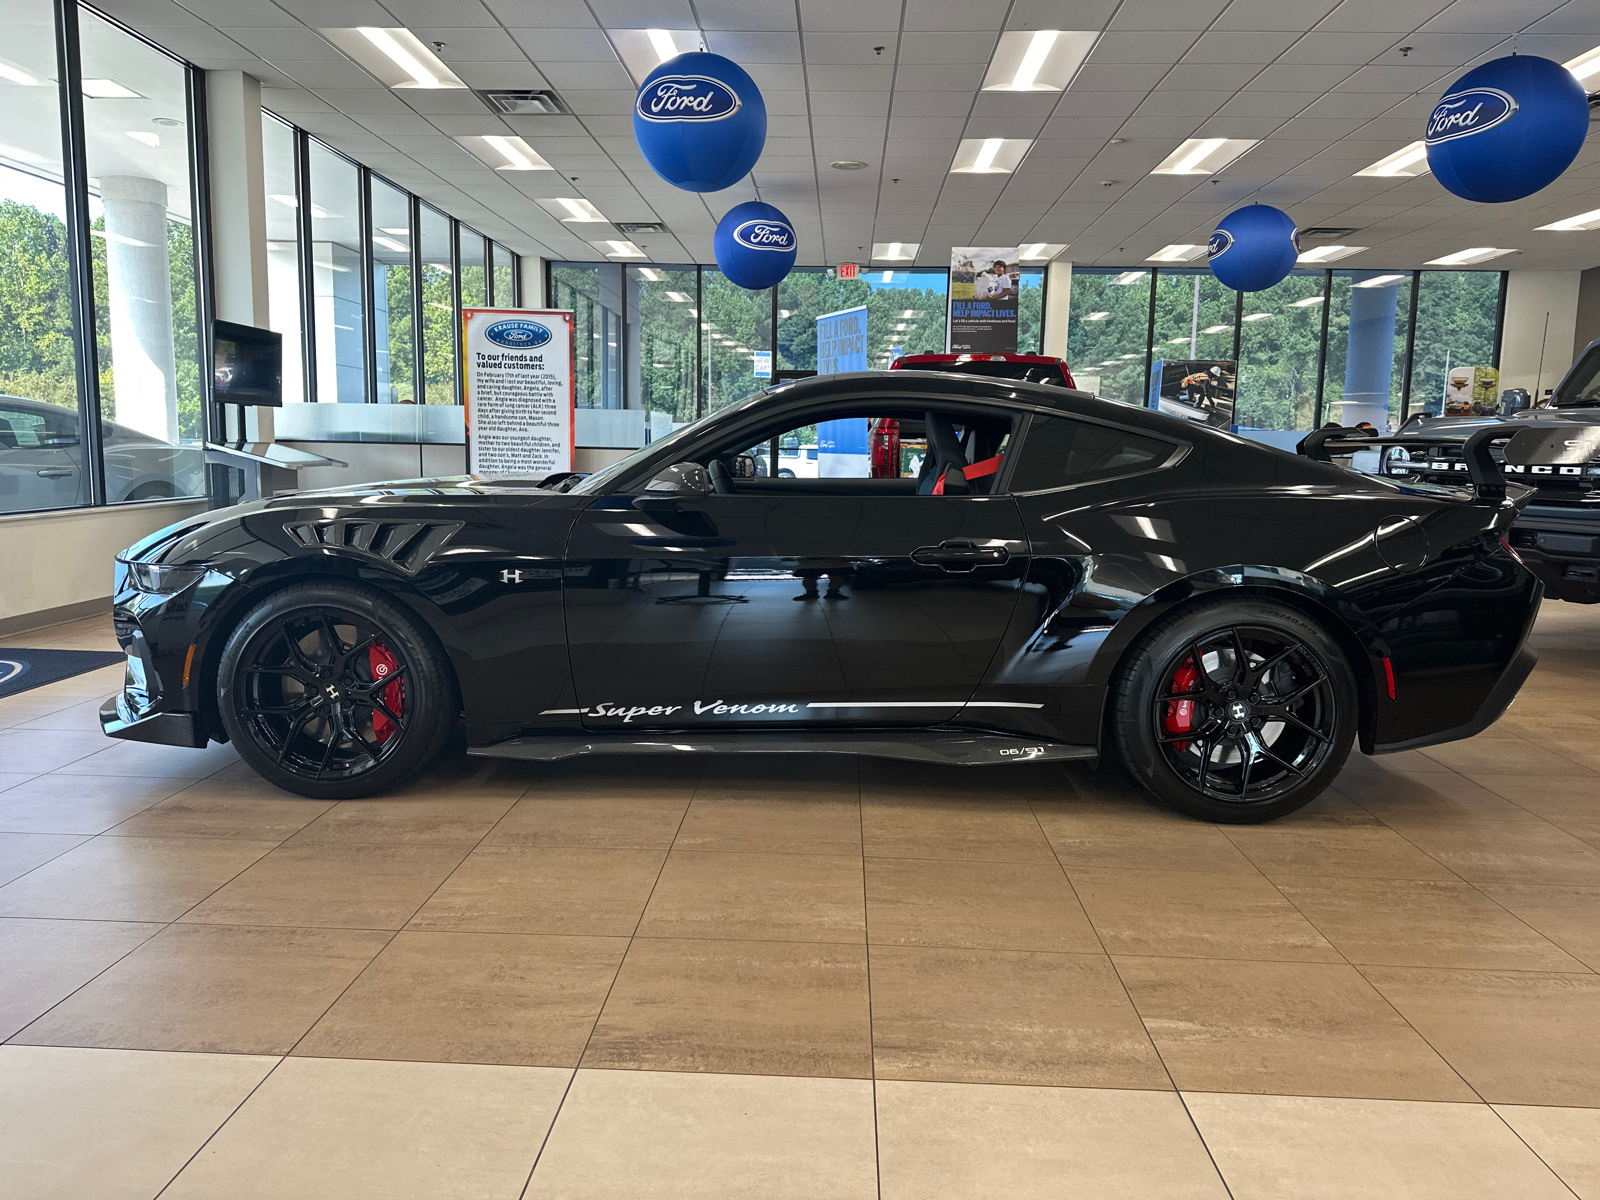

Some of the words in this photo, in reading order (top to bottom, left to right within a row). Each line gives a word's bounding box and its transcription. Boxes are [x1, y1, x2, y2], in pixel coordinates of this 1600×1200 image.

[651, 83, 714, 113] Ford
[1428, 99, 1484, 136] Ford
[750, 224, 788, 246] Ford
[840, 265, 857, 278] EXIT
[996, 310, 1016, 318] LIVES.
[494, 323, 518, 332] KRAUSE
[520, 323, 544, 334] FAMILY
[820, 321, 832, 340] FILL
[834, 319, 838, 338] A
[841, 316, 862, 336] FORD.
[508, 331, 528, 340] Ford
[820, 338, 837, 358] HELP
[838, 334, 864, 356] IMPACT
[501, 353, 527, 362] friends
[477, 361, 502, 369] valued
[504, 362, 545, 370] customers:
[1432, 462, 1582, 476] BRNCO
[588, 702, 682, 722] Super
[693, 699, 800, 716] Venom
